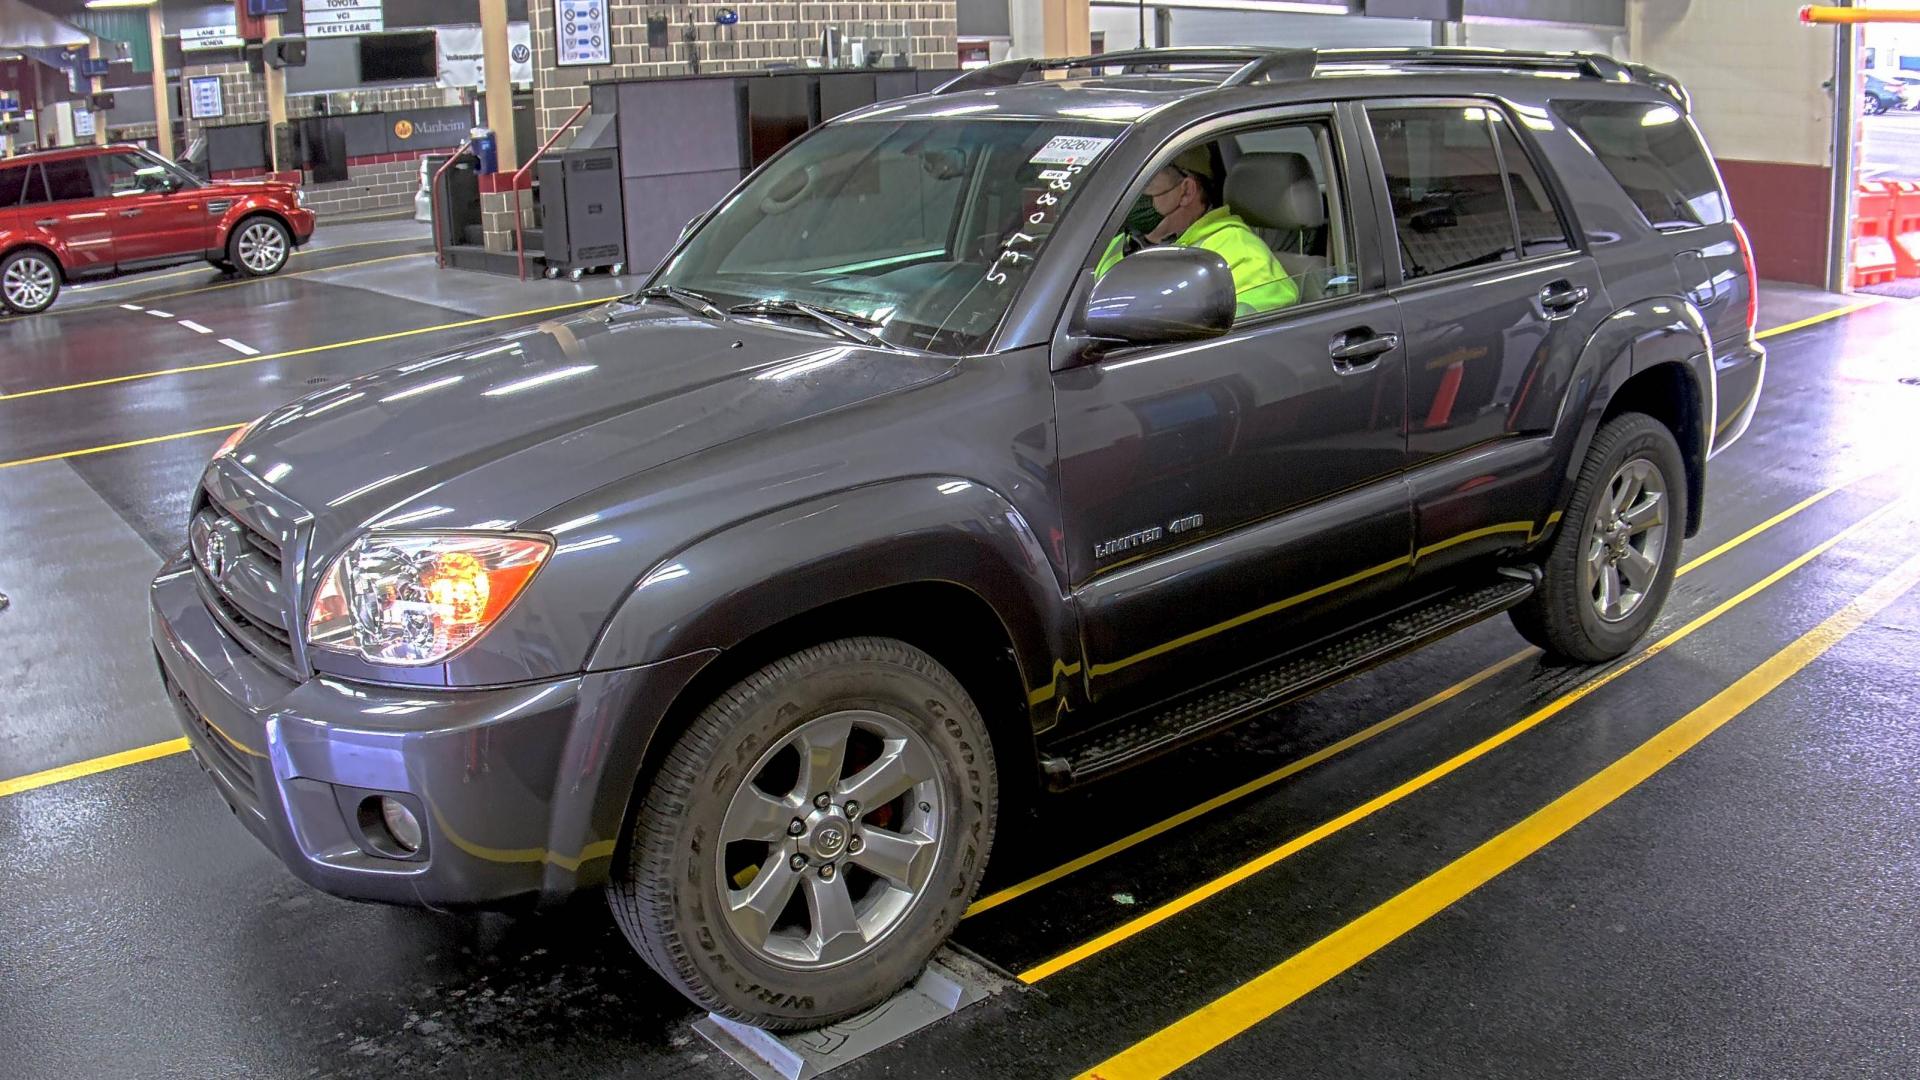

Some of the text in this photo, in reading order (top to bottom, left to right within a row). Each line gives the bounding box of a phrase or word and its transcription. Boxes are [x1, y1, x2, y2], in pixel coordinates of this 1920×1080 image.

[317, 23, 371, 33] FLEET LEASE
[414, 120, 465, 135] Manheim
[1046, 138, 1101, 151] 6782601
[1095, 513, 1204, 558] LIMITED 4WD
